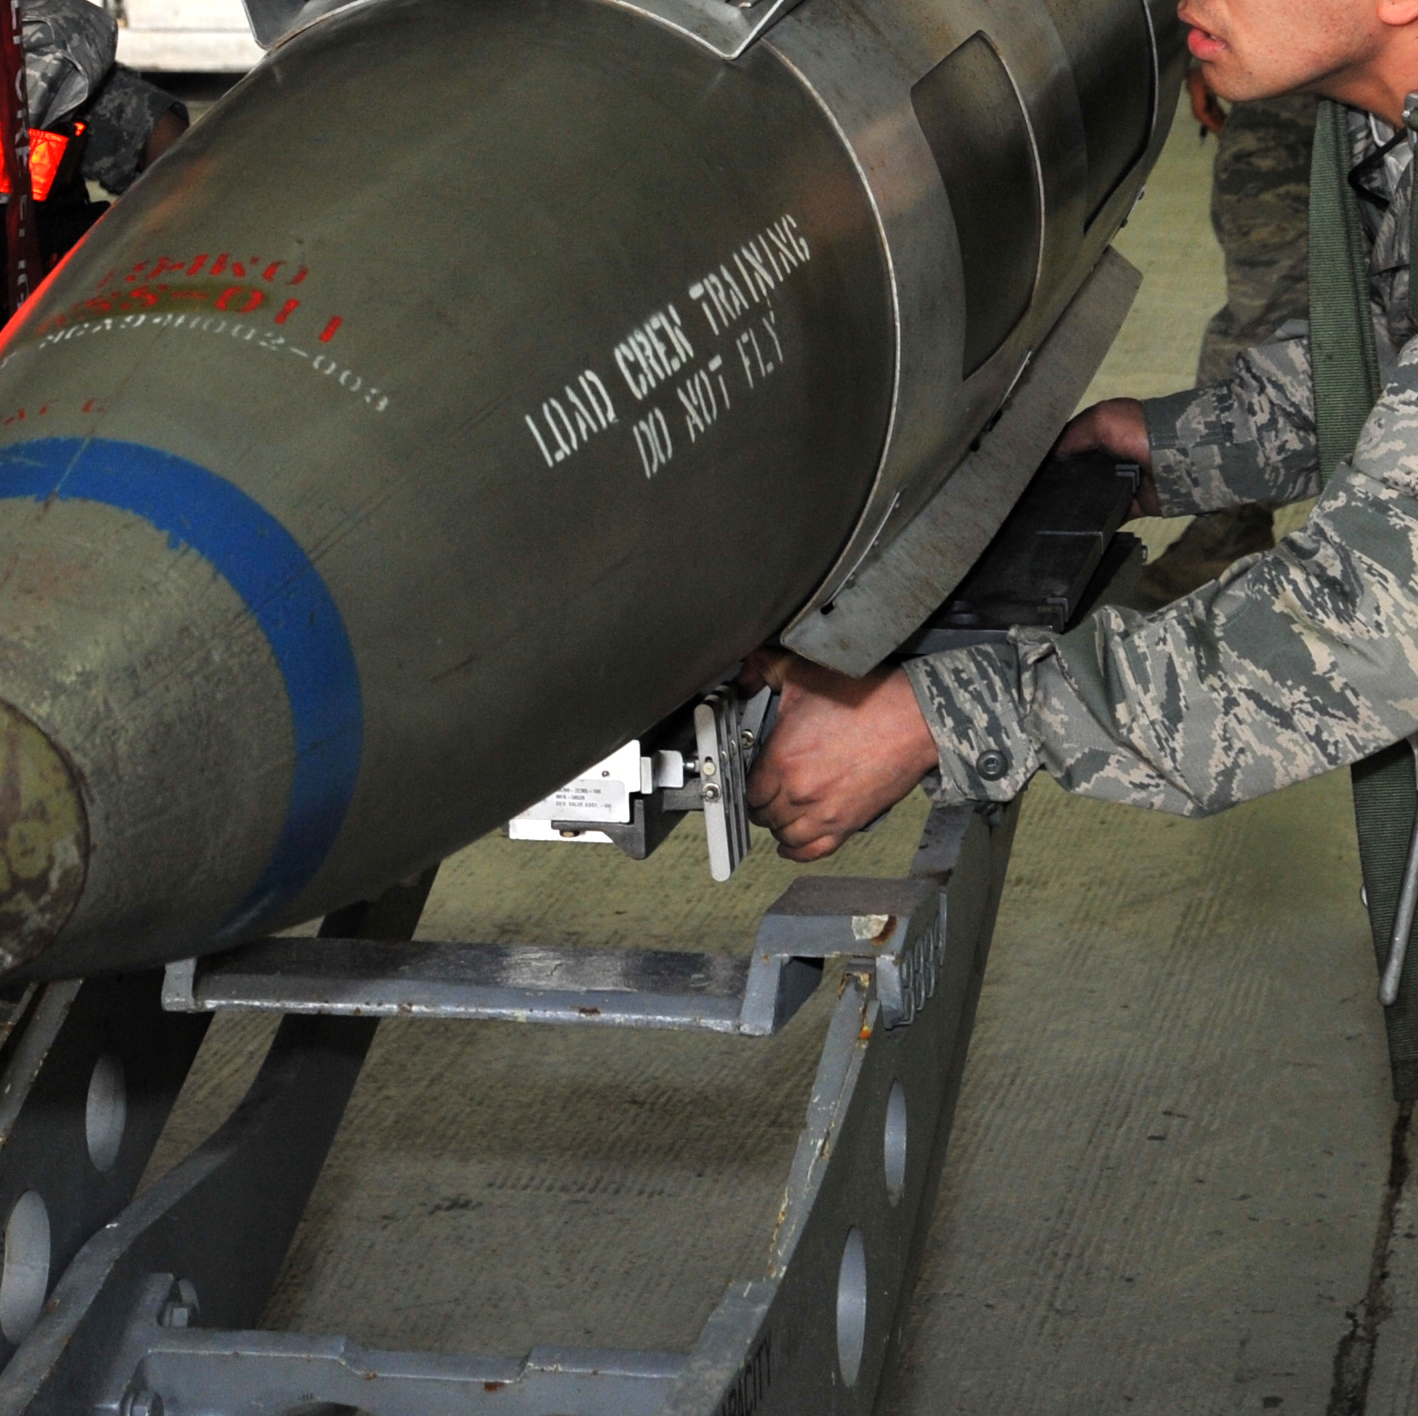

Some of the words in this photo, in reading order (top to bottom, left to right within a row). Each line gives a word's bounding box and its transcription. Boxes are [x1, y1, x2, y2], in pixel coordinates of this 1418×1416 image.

[525, 368, 617, 468] LOAD
[688, 213, 810, 336] TRAINING
[633, 406, 672, 479] DO
[677, 354, 731, 444] NOT
[736, 312, 783, 388] FLY
